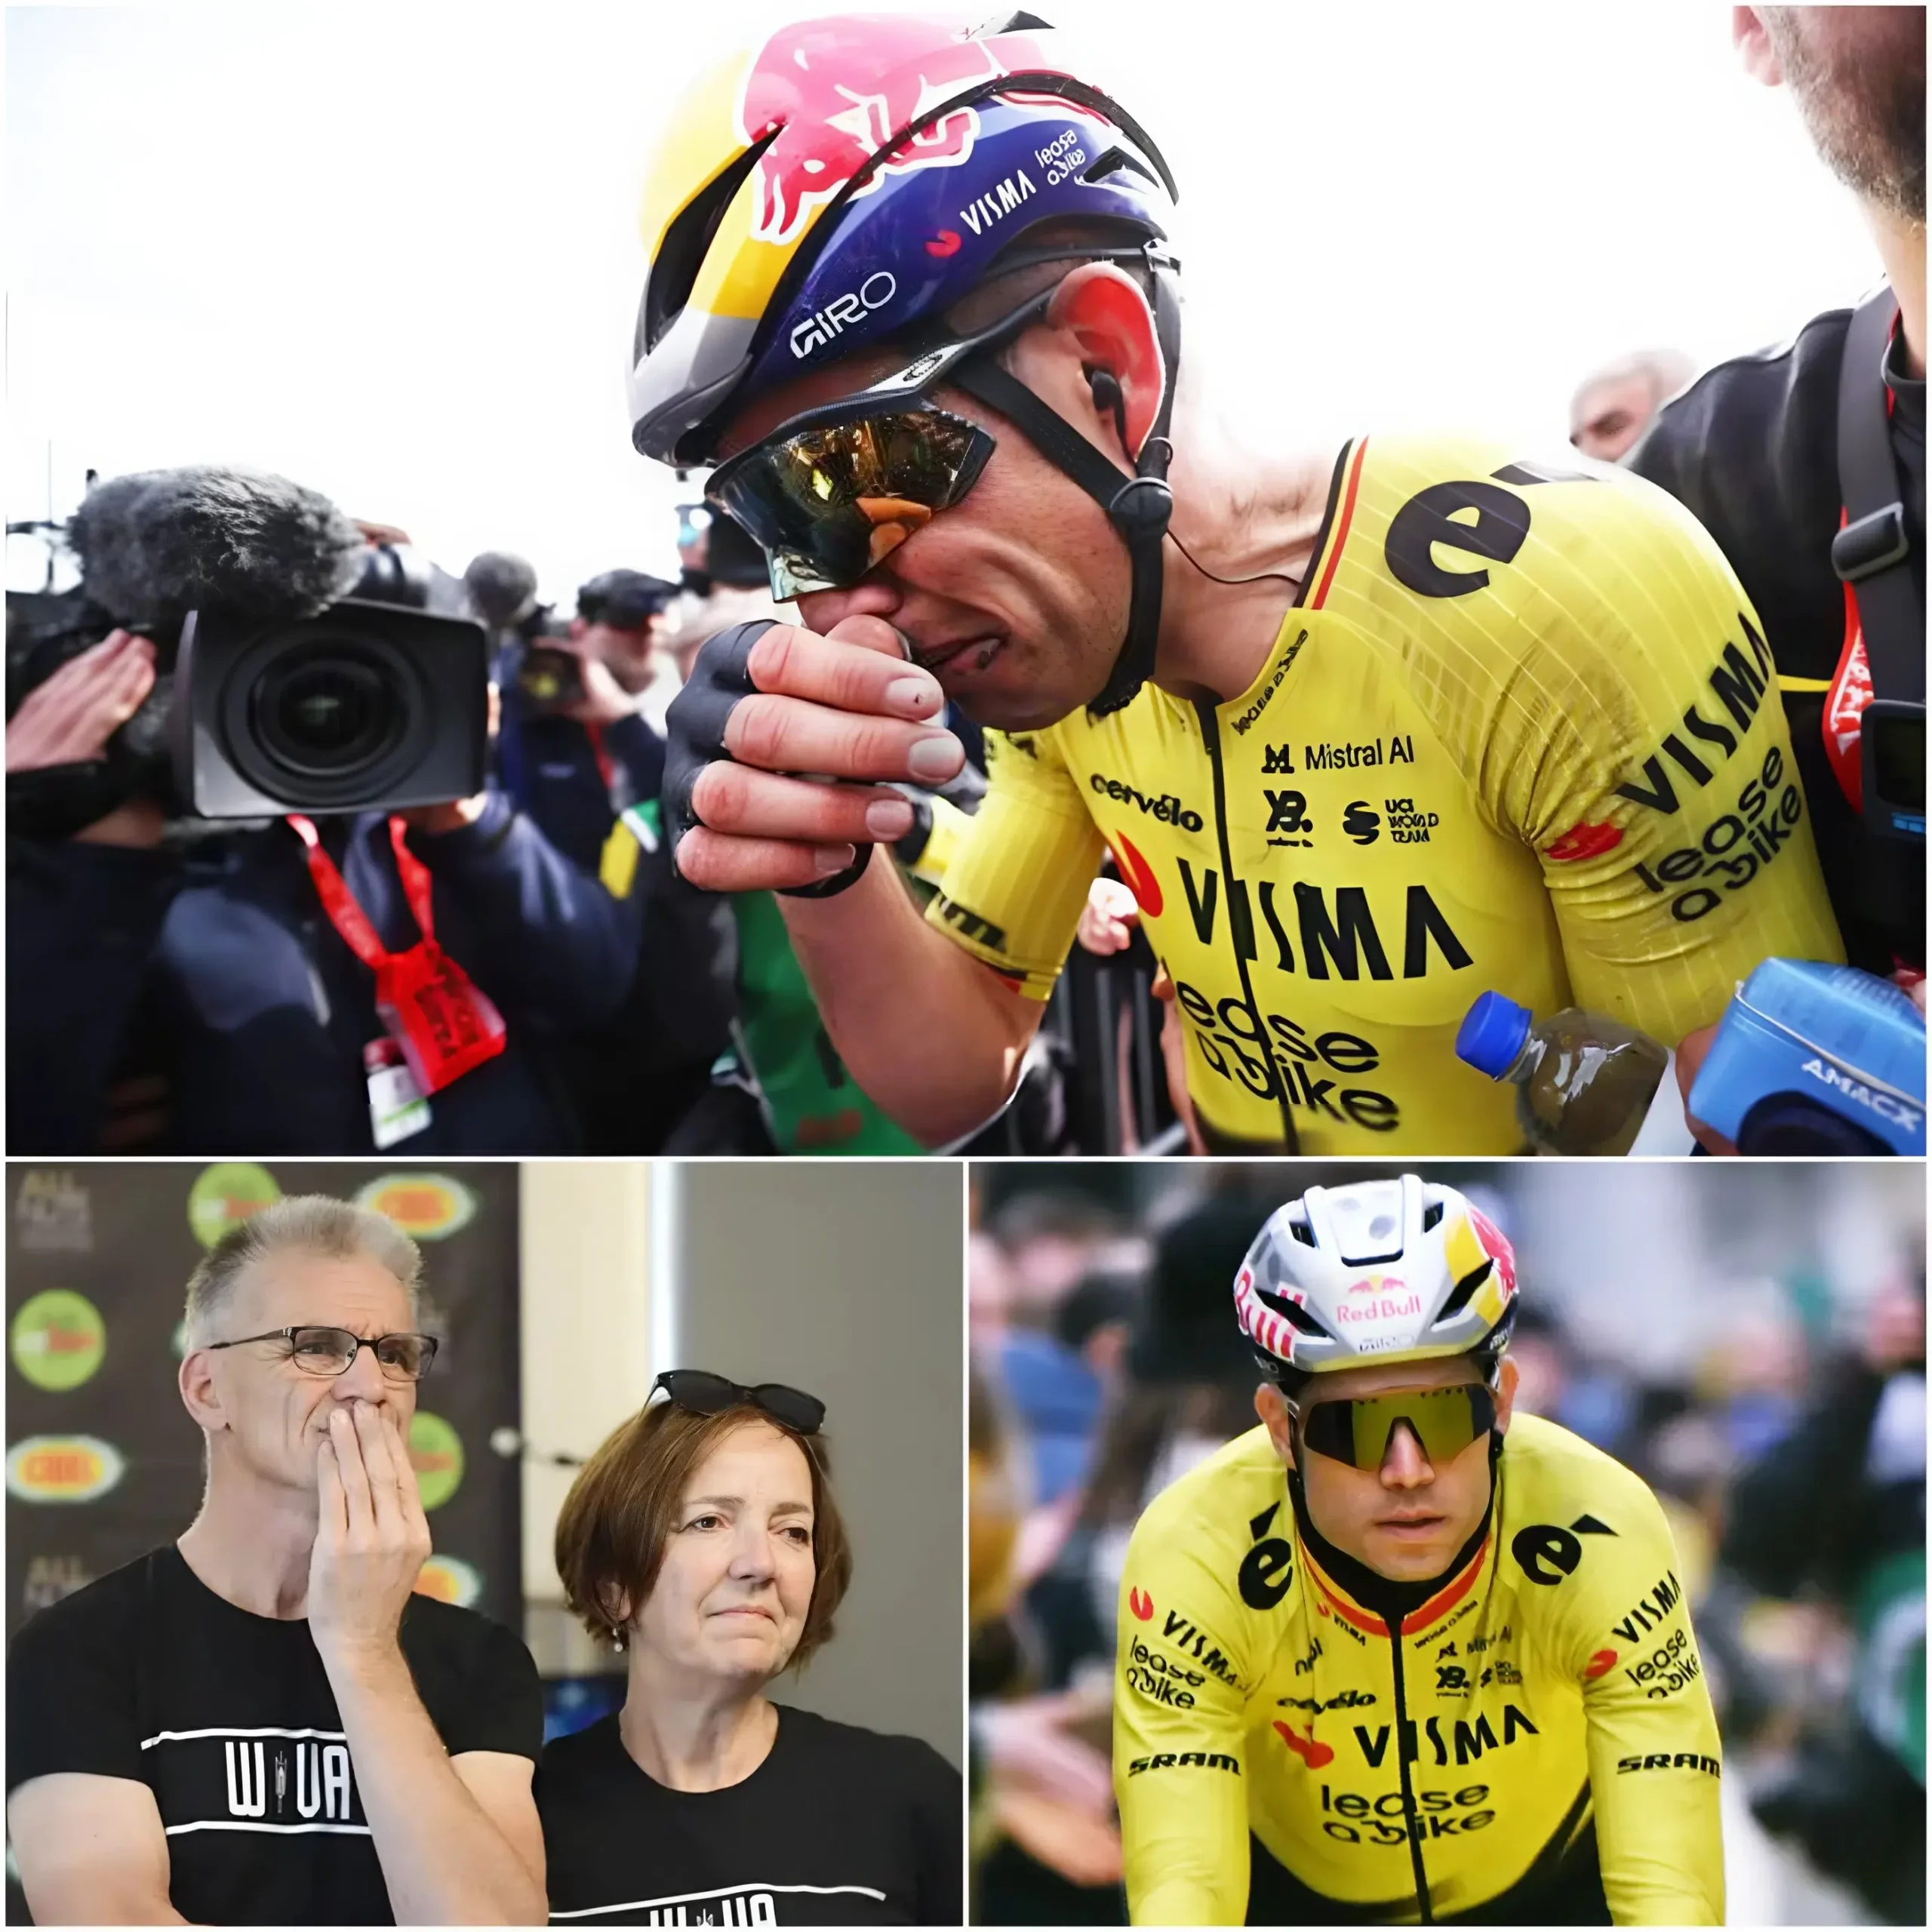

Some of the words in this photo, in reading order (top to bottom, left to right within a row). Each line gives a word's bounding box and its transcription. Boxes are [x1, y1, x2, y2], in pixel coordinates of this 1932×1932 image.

[960, 170, 1037, 235] VISMA
[790, 272, 896, 358] GIRO
[1614, 611, 1774, 815] VISMA
[1305, 737, 1383, 771] Mistral
[1389, 735, 1415, 764] AI
[1632, 746, 1784, 894] lease
[1176, 857, 1474, 981] VISMA
[1337, 1300, 1378, 1324] Red
[1380, 1295, 1421, 1318] Bull
[1611, 1569, 1681, 1644] VISMA
[1625, 1629, 1687, 1687] lease
[1128, 1752, 1241, 1778] SRAM
[1353, 1704, 1541, 1768] VISMA
[1617, 1753, 1721, 1779] SRAM
[1321, 1784, 1490, 1819] lease
